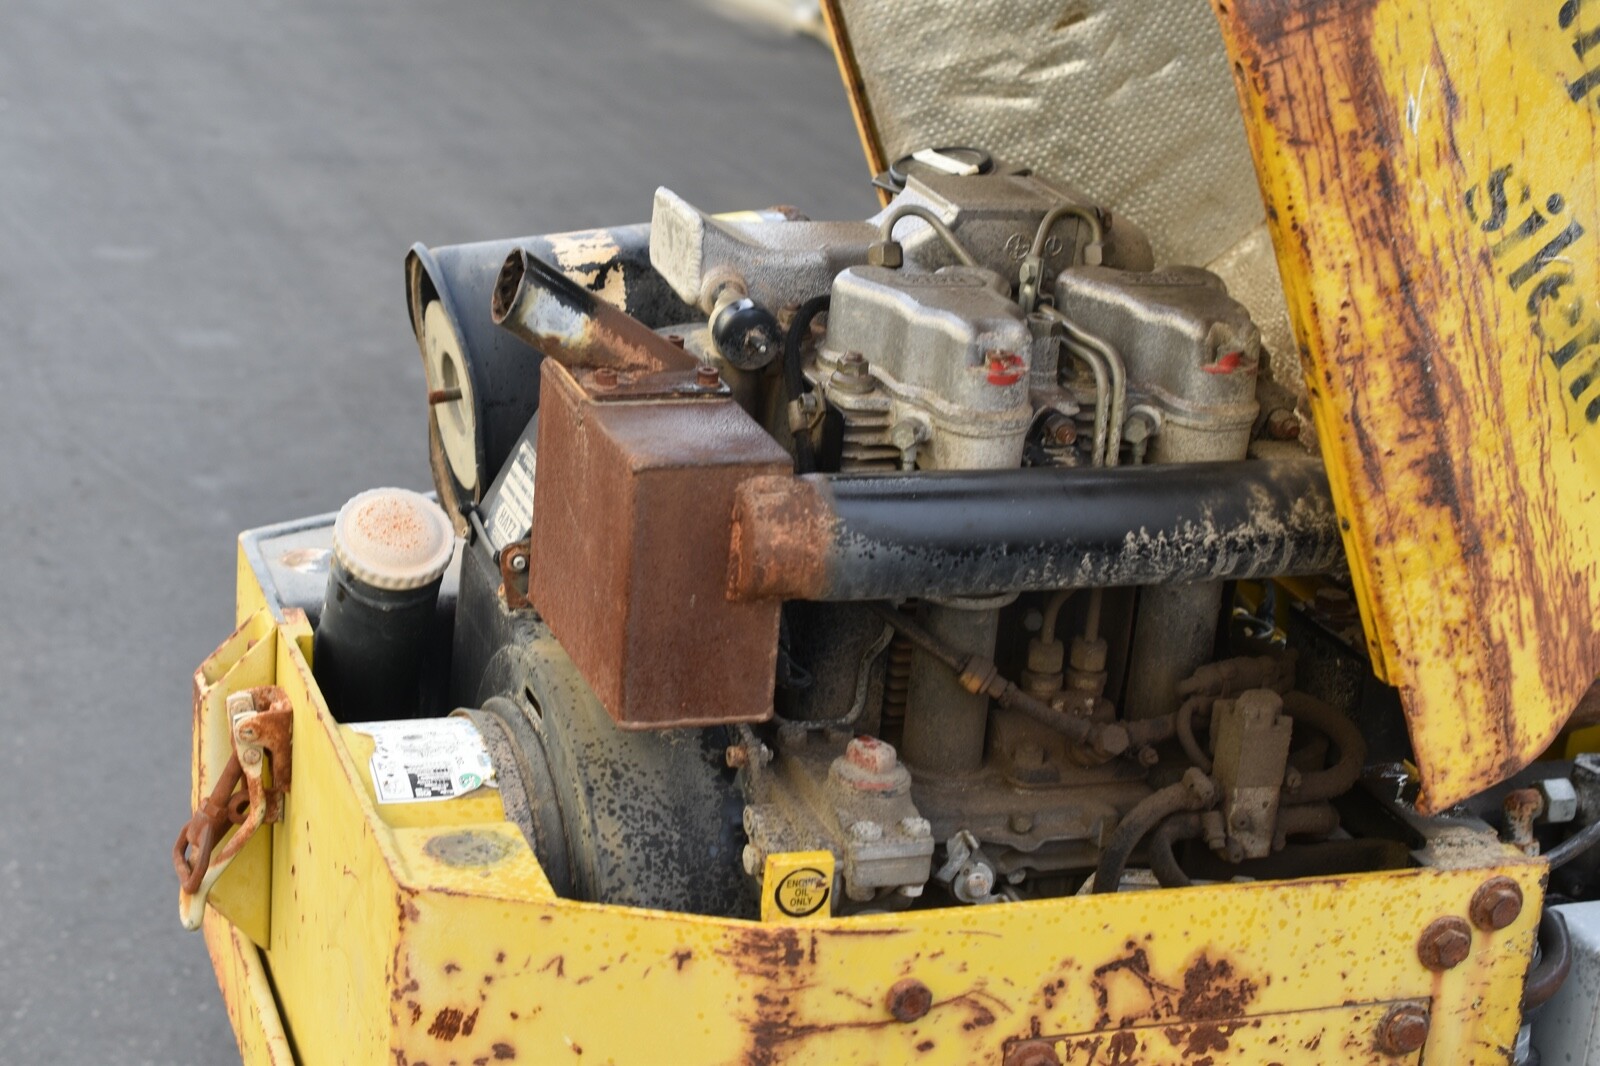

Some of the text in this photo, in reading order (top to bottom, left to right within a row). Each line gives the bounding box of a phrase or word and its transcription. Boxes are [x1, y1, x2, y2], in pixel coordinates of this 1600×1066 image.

[497, 506, 517, 540] HATZ
[795, 888, 808, 897] OIL
[790, 897, 813, 907] ONLY
